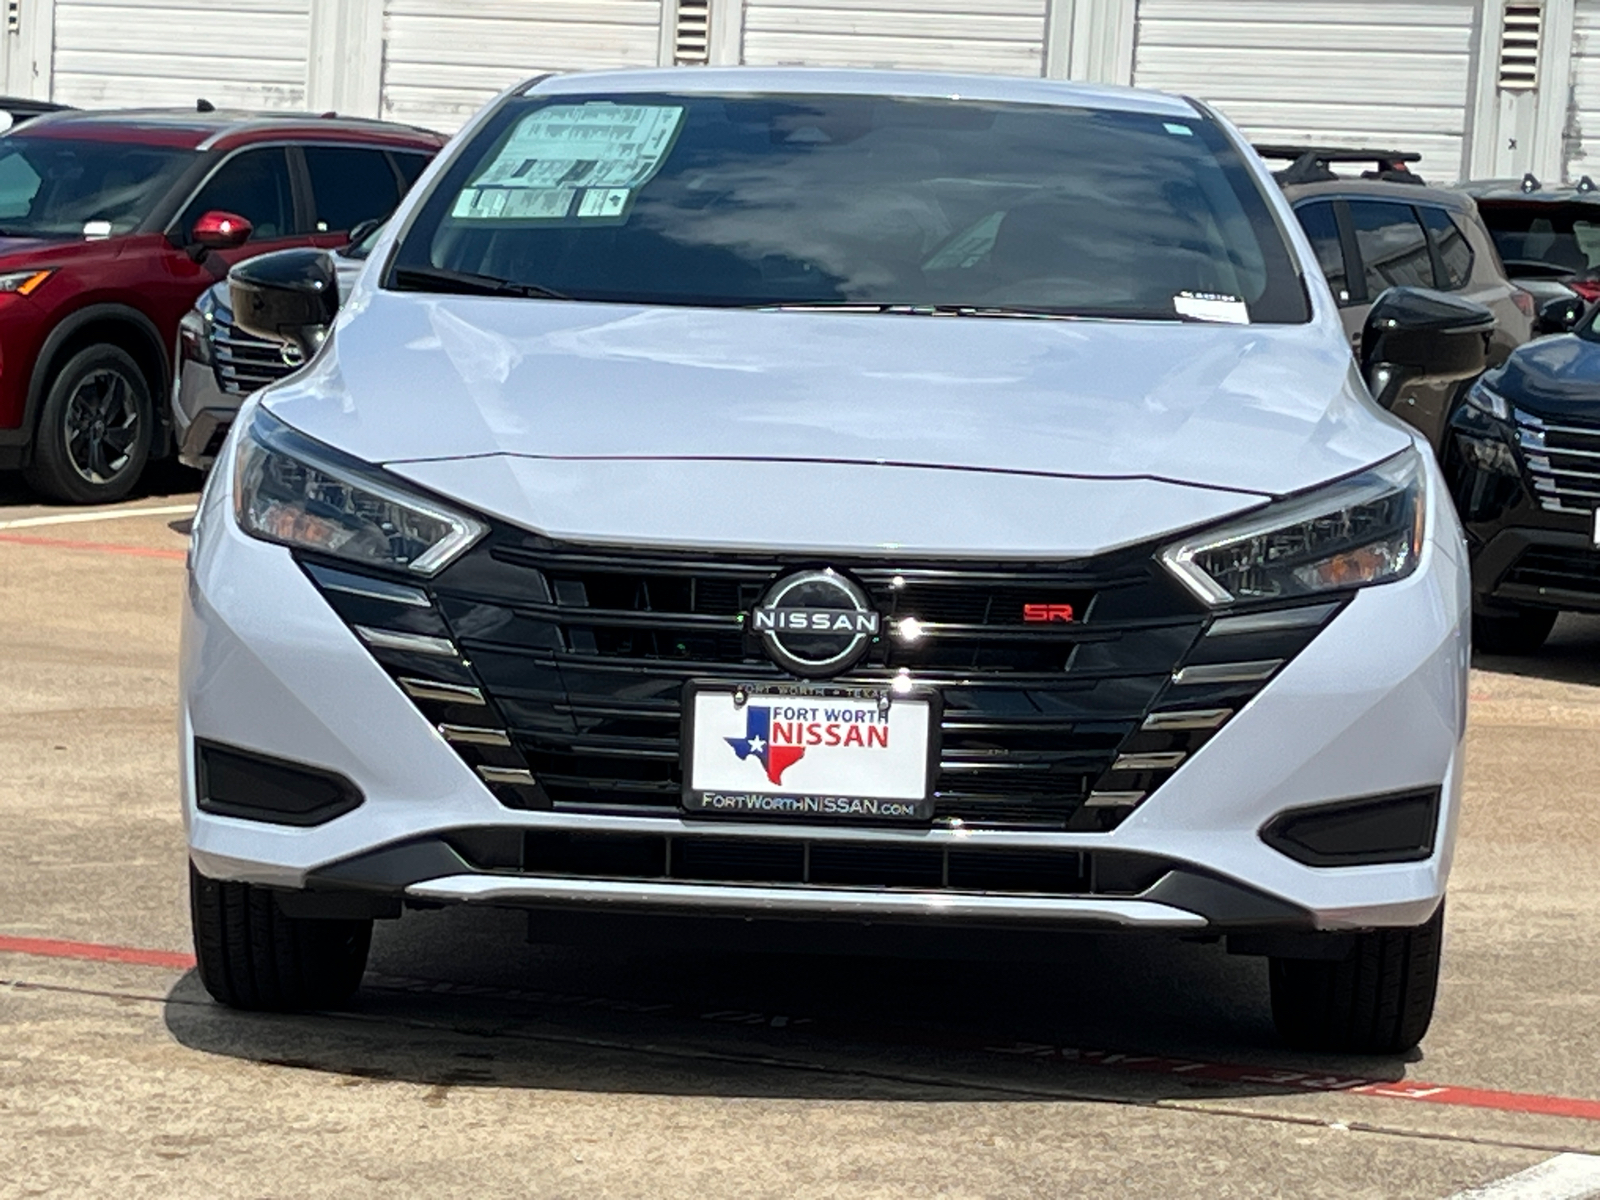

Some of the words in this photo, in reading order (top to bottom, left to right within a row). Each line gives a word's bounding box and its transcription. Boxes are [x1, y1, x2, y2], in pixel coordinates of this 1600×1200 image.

[755, 611, 877, 631] NISSAN
[1023, 604, 1073, 622] SR
[772, 706, 819, 721] FORT
[824, 708, 889, 724] WORTH
[772, 721, 889, 748] NISSAN
